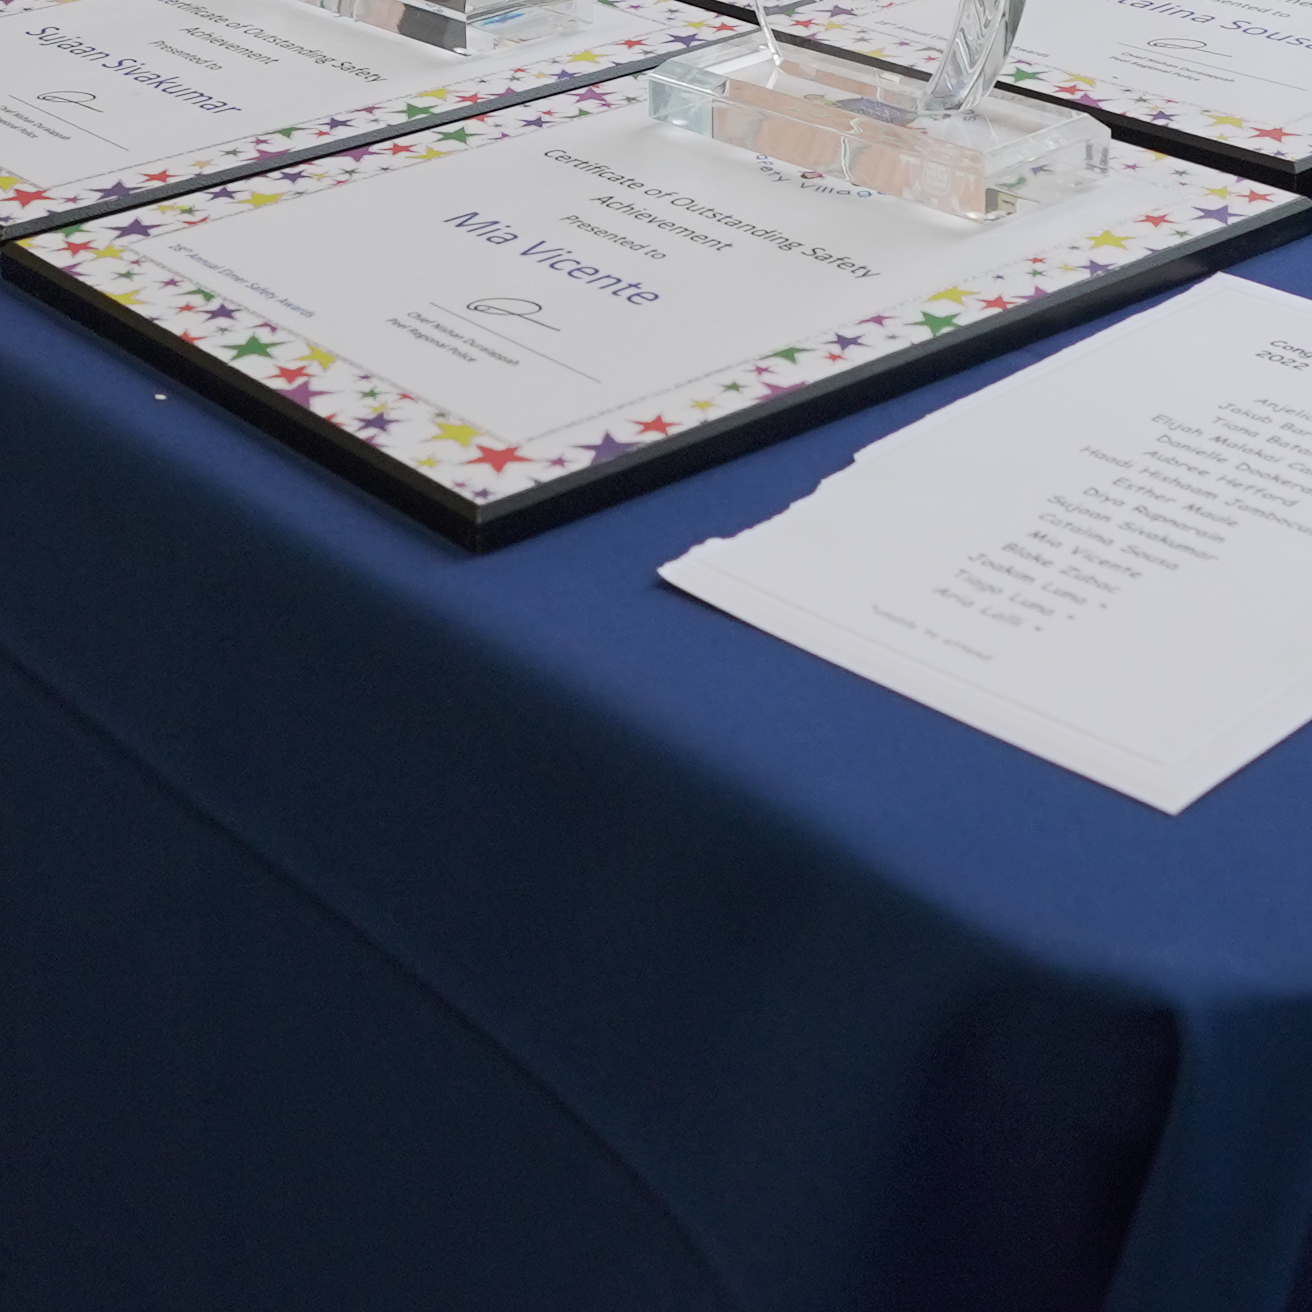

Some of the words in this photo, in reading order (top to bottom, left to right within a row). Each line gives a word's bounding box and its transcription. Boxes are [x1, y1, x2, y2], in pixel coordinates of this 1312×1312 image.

[25, 27, 110, 61] Sujaan
[102, 59, 242, 113] Sivakumar
[149, 40, 213, 64] Presented
[180, 27, 279, 65] Achievement
[243, 28, 337, 64] Outstanding
[331, 62, 386, 82] Safety
[544, 150, 644, 189] Certificate
[644, 189, 678, 198] of
[670, 198, 804, 251] Outstanding
[801, 247, 879, 278] Safety
[560, 215, 650, 251] Presented
[644, 249, 666, 259] to
[590, 196, 732, 251] Achievement
[444, 212, 518, 245] Mia
[520, 240, 659, 305] Vicente
[1256, 351, 1309, 370] 2022
